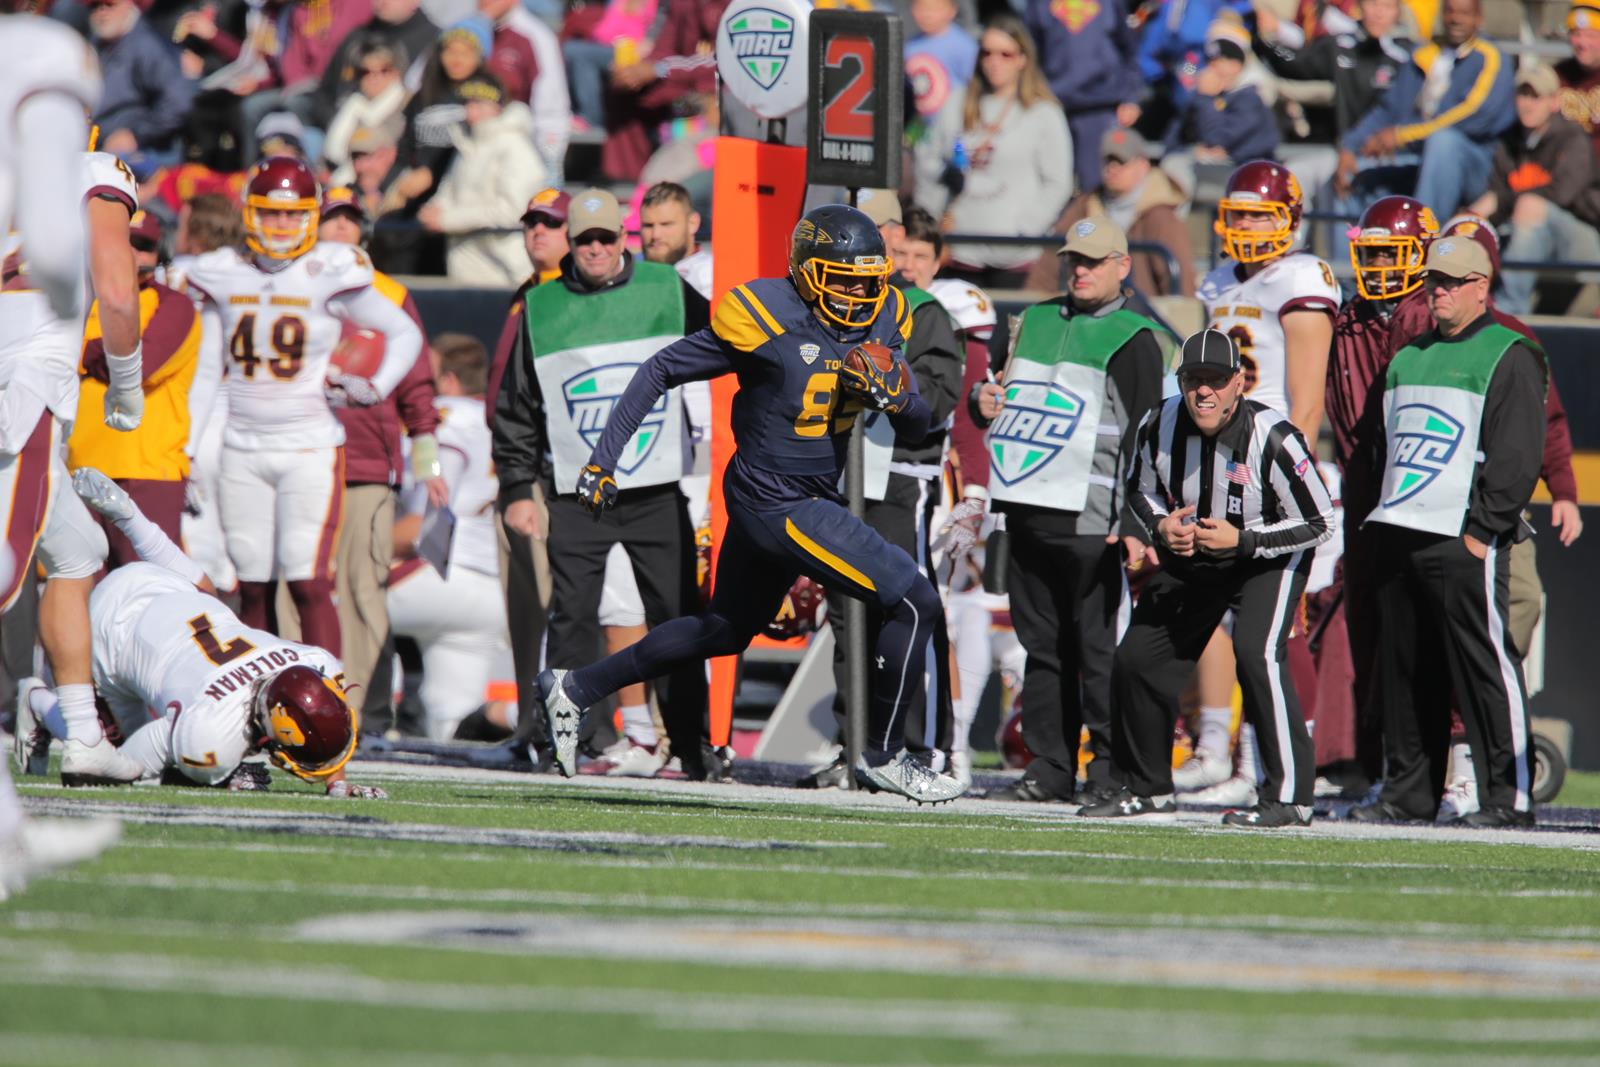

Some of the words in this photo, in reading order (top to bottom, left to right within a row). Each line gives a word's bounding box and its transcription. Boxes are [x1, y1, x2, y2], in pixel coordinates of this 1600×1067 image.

[736, 33, 793, 57] MAC
[825, 35, 875, 140] 2
[229, 312, 307, 382] 49
[799, 349, 820, 357] MAC
[1227, 495, 1242, 515] H
[186, 613, 257, 668] 7
[204, 647, 300, 701] COLEMAN
